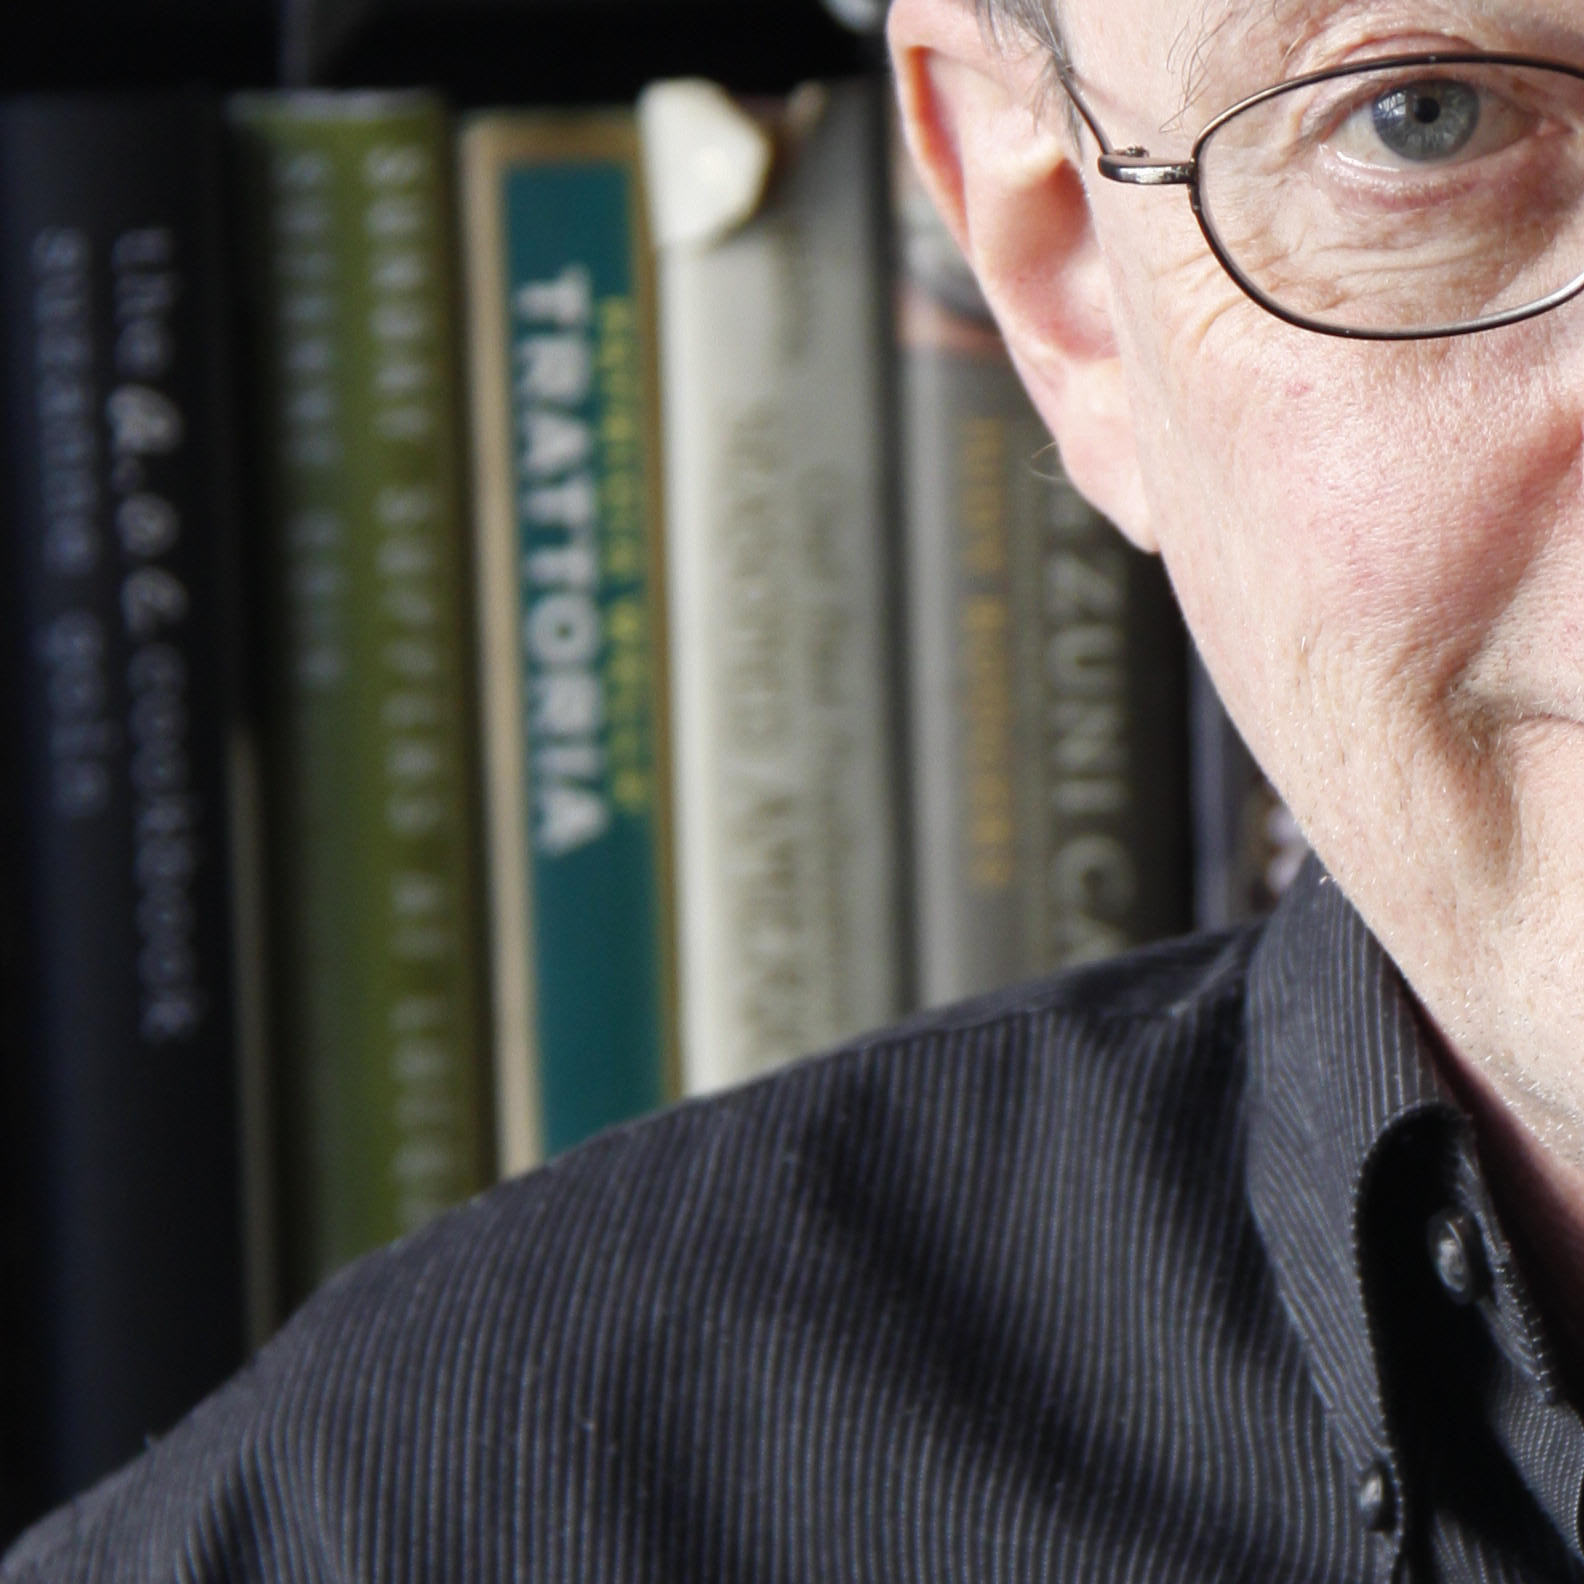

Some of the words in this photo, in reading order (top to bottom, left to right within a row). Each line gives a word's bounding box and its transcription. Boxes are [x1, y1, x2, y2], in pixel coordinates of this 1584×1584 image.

[32, 224, 102, 581] suzanne
[42, 610, 118, 816] goin
[512, 262, 608, 858] TRATTORIA
[1044, 551, 1128, 814] ZUNI
